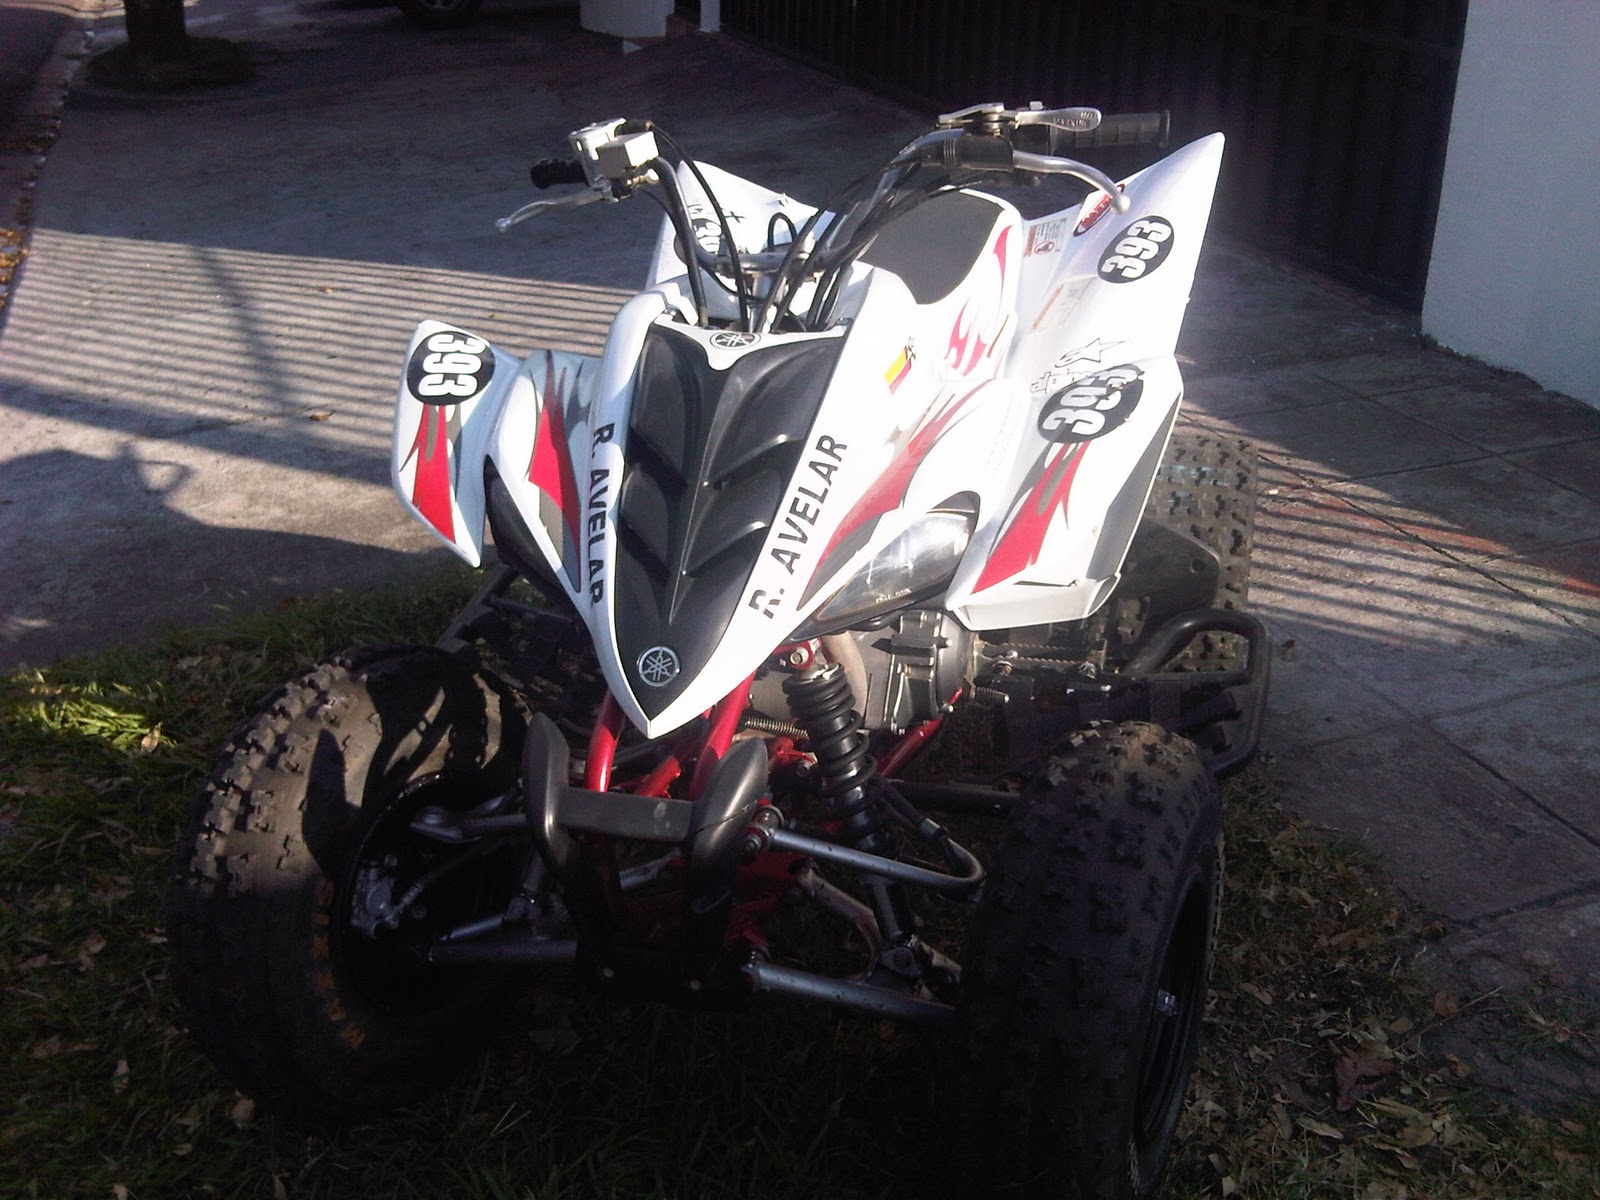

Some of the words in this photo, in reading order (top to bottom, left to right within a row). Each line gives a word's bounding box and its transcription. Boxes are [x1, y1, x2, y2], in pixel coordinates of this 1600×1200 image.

[1101, 220, 1172, 279] 393
[418, 334, 486, 397] 393
[1042, 368, 1138, 436] 393
[587, 468, 610, 605] AVELAR
[748, 588, 785, 620] R.
[770, 434, 848, 576] AVELAR
